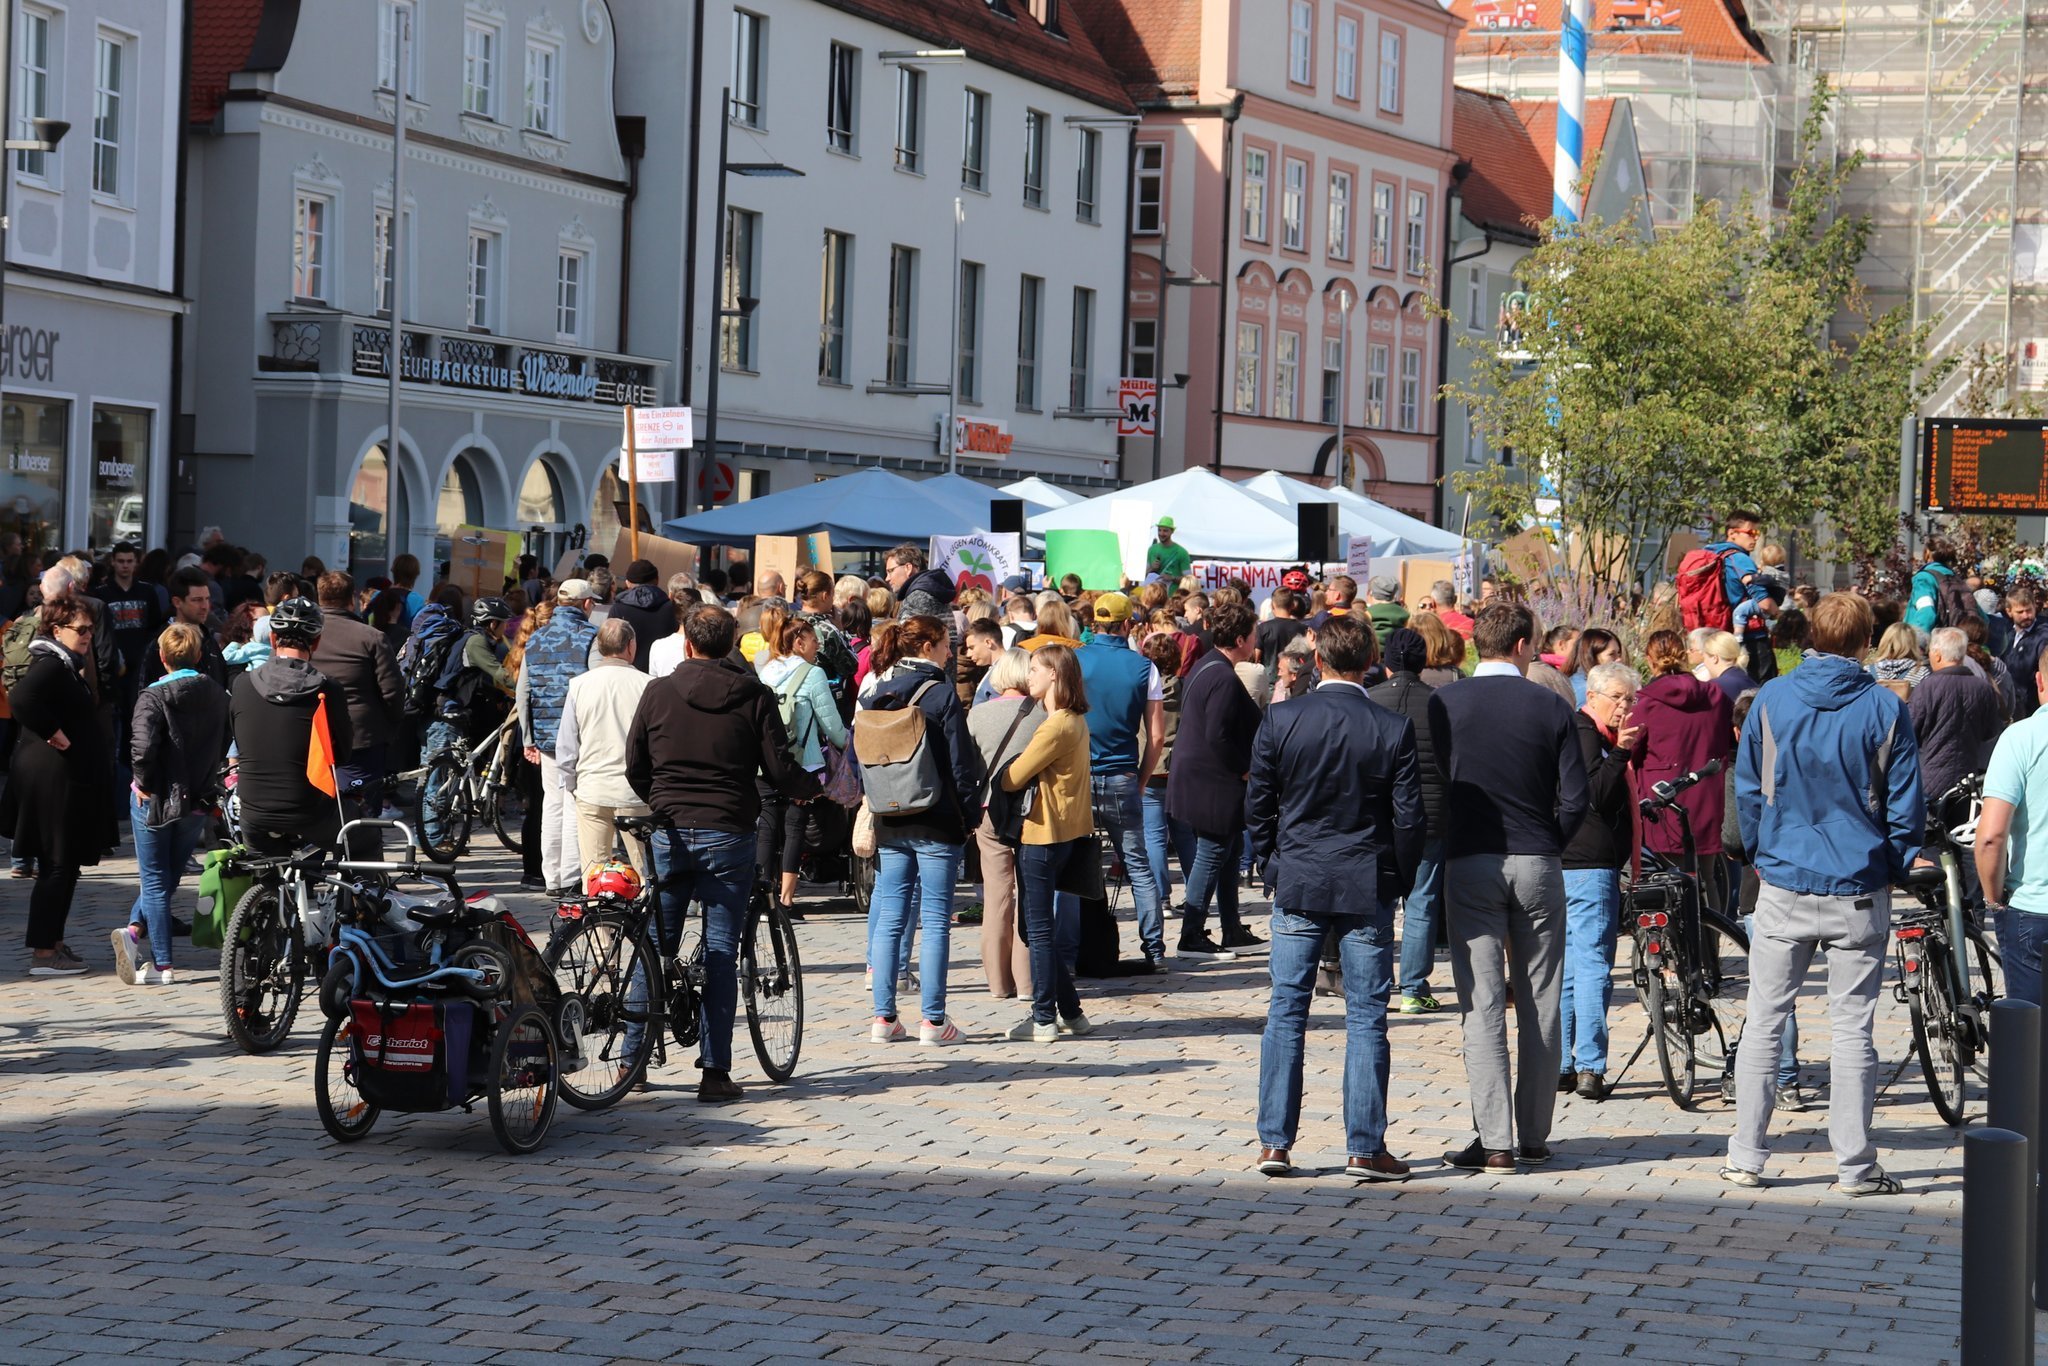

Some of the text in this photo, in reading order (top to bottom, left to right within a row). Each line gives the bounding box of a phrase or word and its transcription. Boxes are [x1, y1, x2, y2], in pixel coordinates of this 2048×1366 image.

[383, 352, 599, 398] NTURBACKSTUBE Wiesender
[1120, 380, 1157, 390] Mülle
[968, 422, 1014, 454] Müller
[968, 537, 1009, 569] ATOMKRAFT
